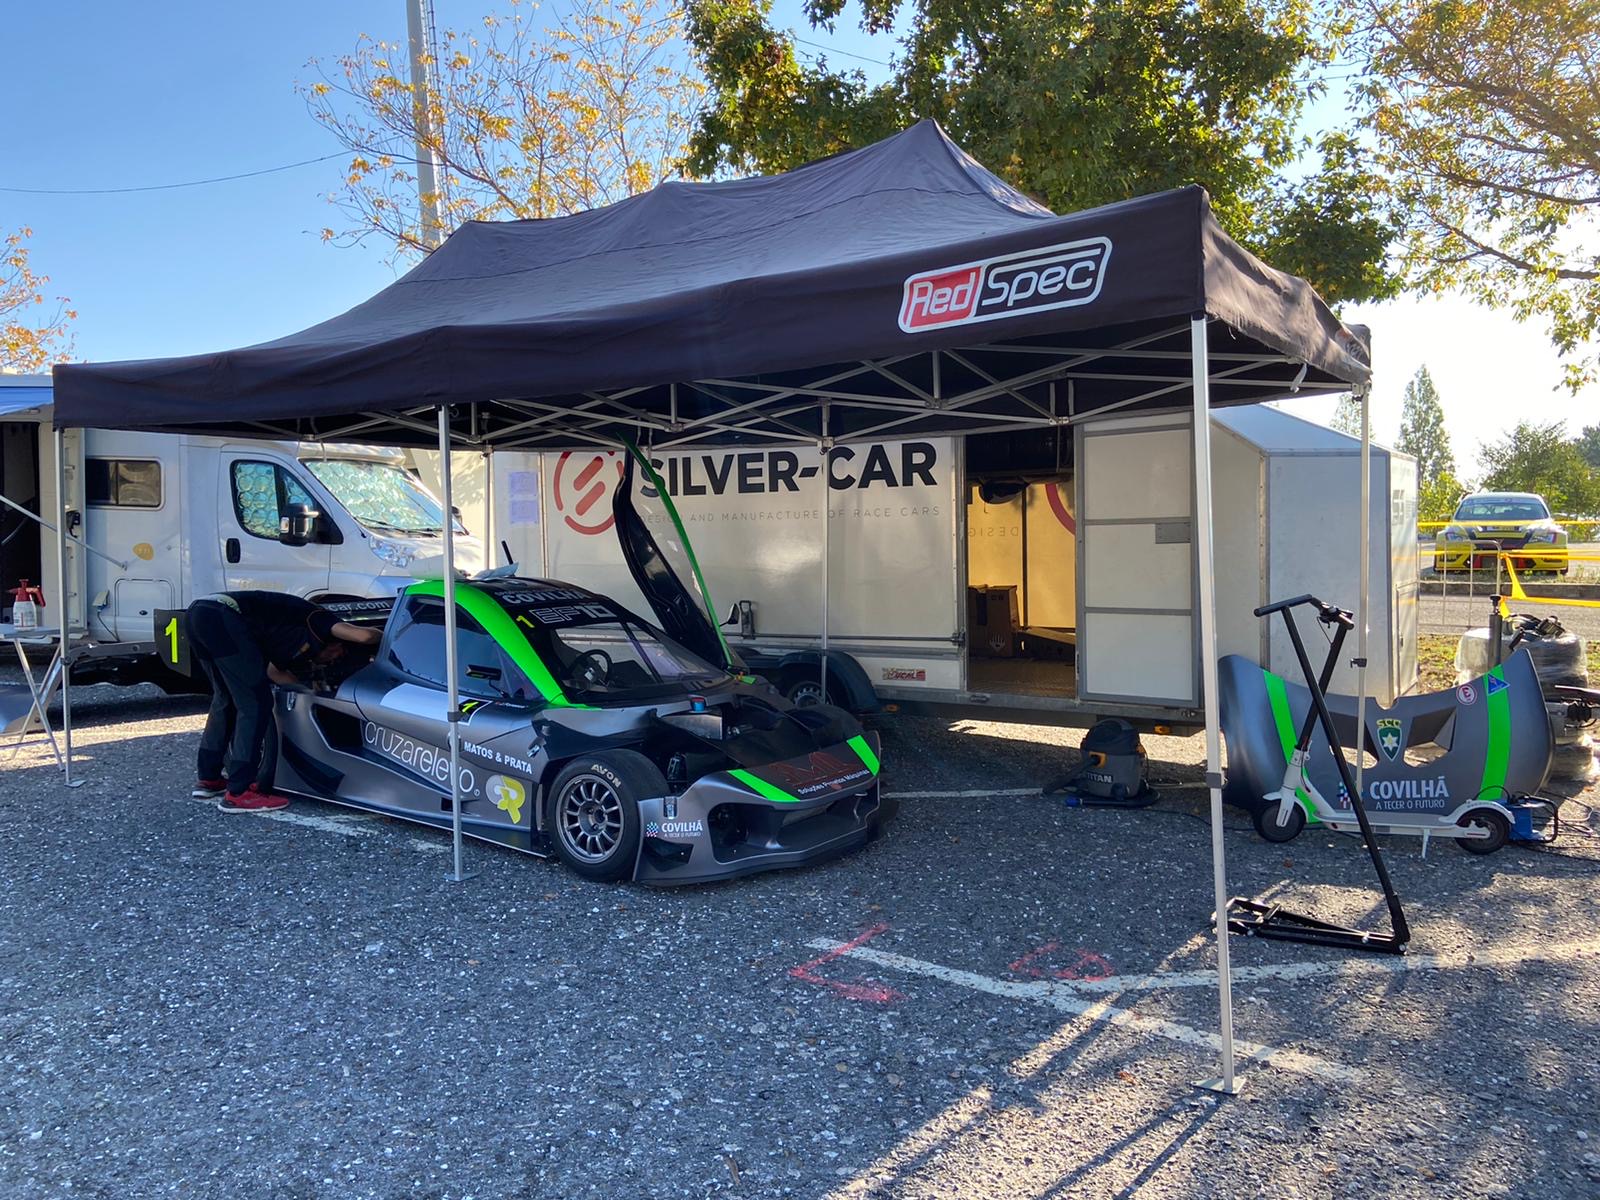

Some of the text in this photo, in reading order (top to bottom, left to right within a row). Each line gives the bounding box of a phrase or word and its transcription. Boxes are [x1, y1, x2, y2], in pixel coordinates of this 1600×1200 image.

[640, 442, 938, 498] SILVER-CAR
[690, 513, 714, 522] AND
[721, 509, 819, 522] MANUFACTURE
[853, 507, 892, 518] RACE
[900, 506, 940, 518] CARS
[515, 615, 536, 628] 1
[528, 604, 618, 624] EF10
[164, 617, 179, 664] 1
[365, 721, 475, 793] cruzareleo
[464, 741, 533, 775] MATOS & PRATA
[591, 763, 622, 789] AVON
[1369, 775, 1450, 800] COVILHÃ
[1375, 798, 1445, 810] A TECER O FUTURO
[661, 819, 703, 833] COVILHÃ
